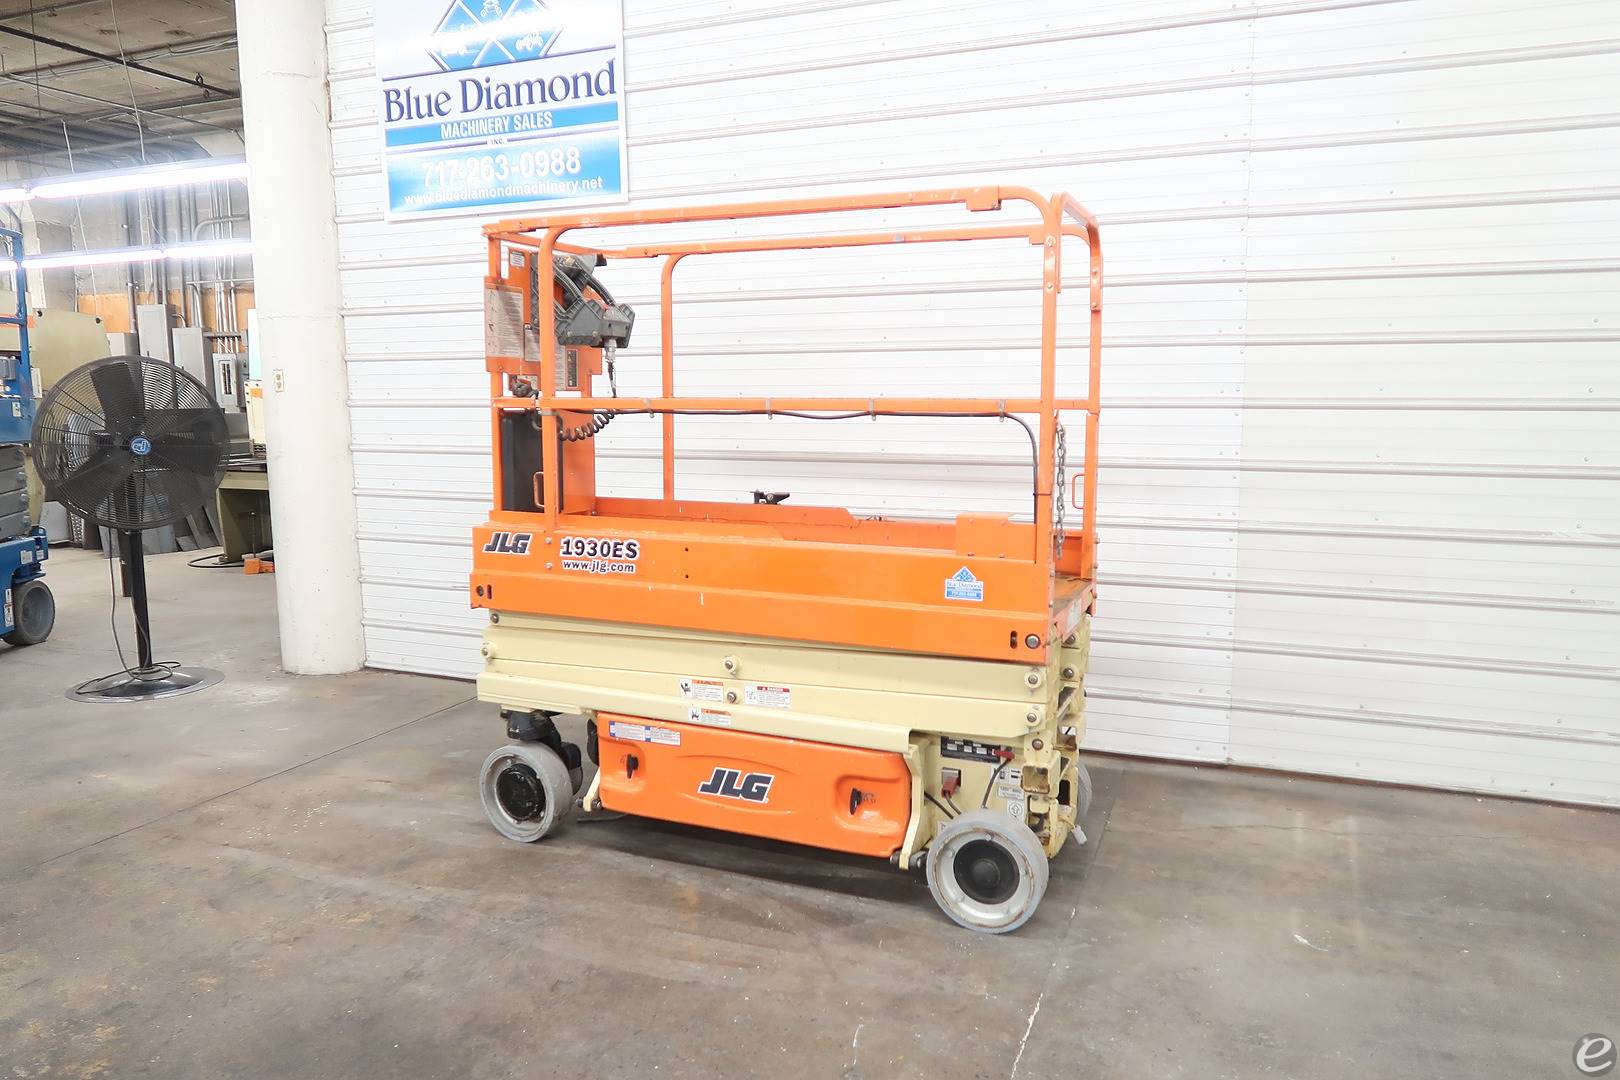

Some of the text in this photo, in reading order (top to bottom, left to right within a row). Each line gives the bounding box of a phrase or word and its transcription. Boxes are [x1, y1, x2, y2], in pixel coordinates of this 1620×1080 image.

[382, 57, 617, 123] Blue Diamond
[440, 111, 553, 140] MACHINERY SALES
[404, 175, 603, 205] www.bluediamondmachinery.net
[484, 532, 531, 554] JLG
[561, 537, 639, 560] 1930ES
[562, 560, 635, 573] www.jlg.com
[699, 768, 774, 802] JLG
